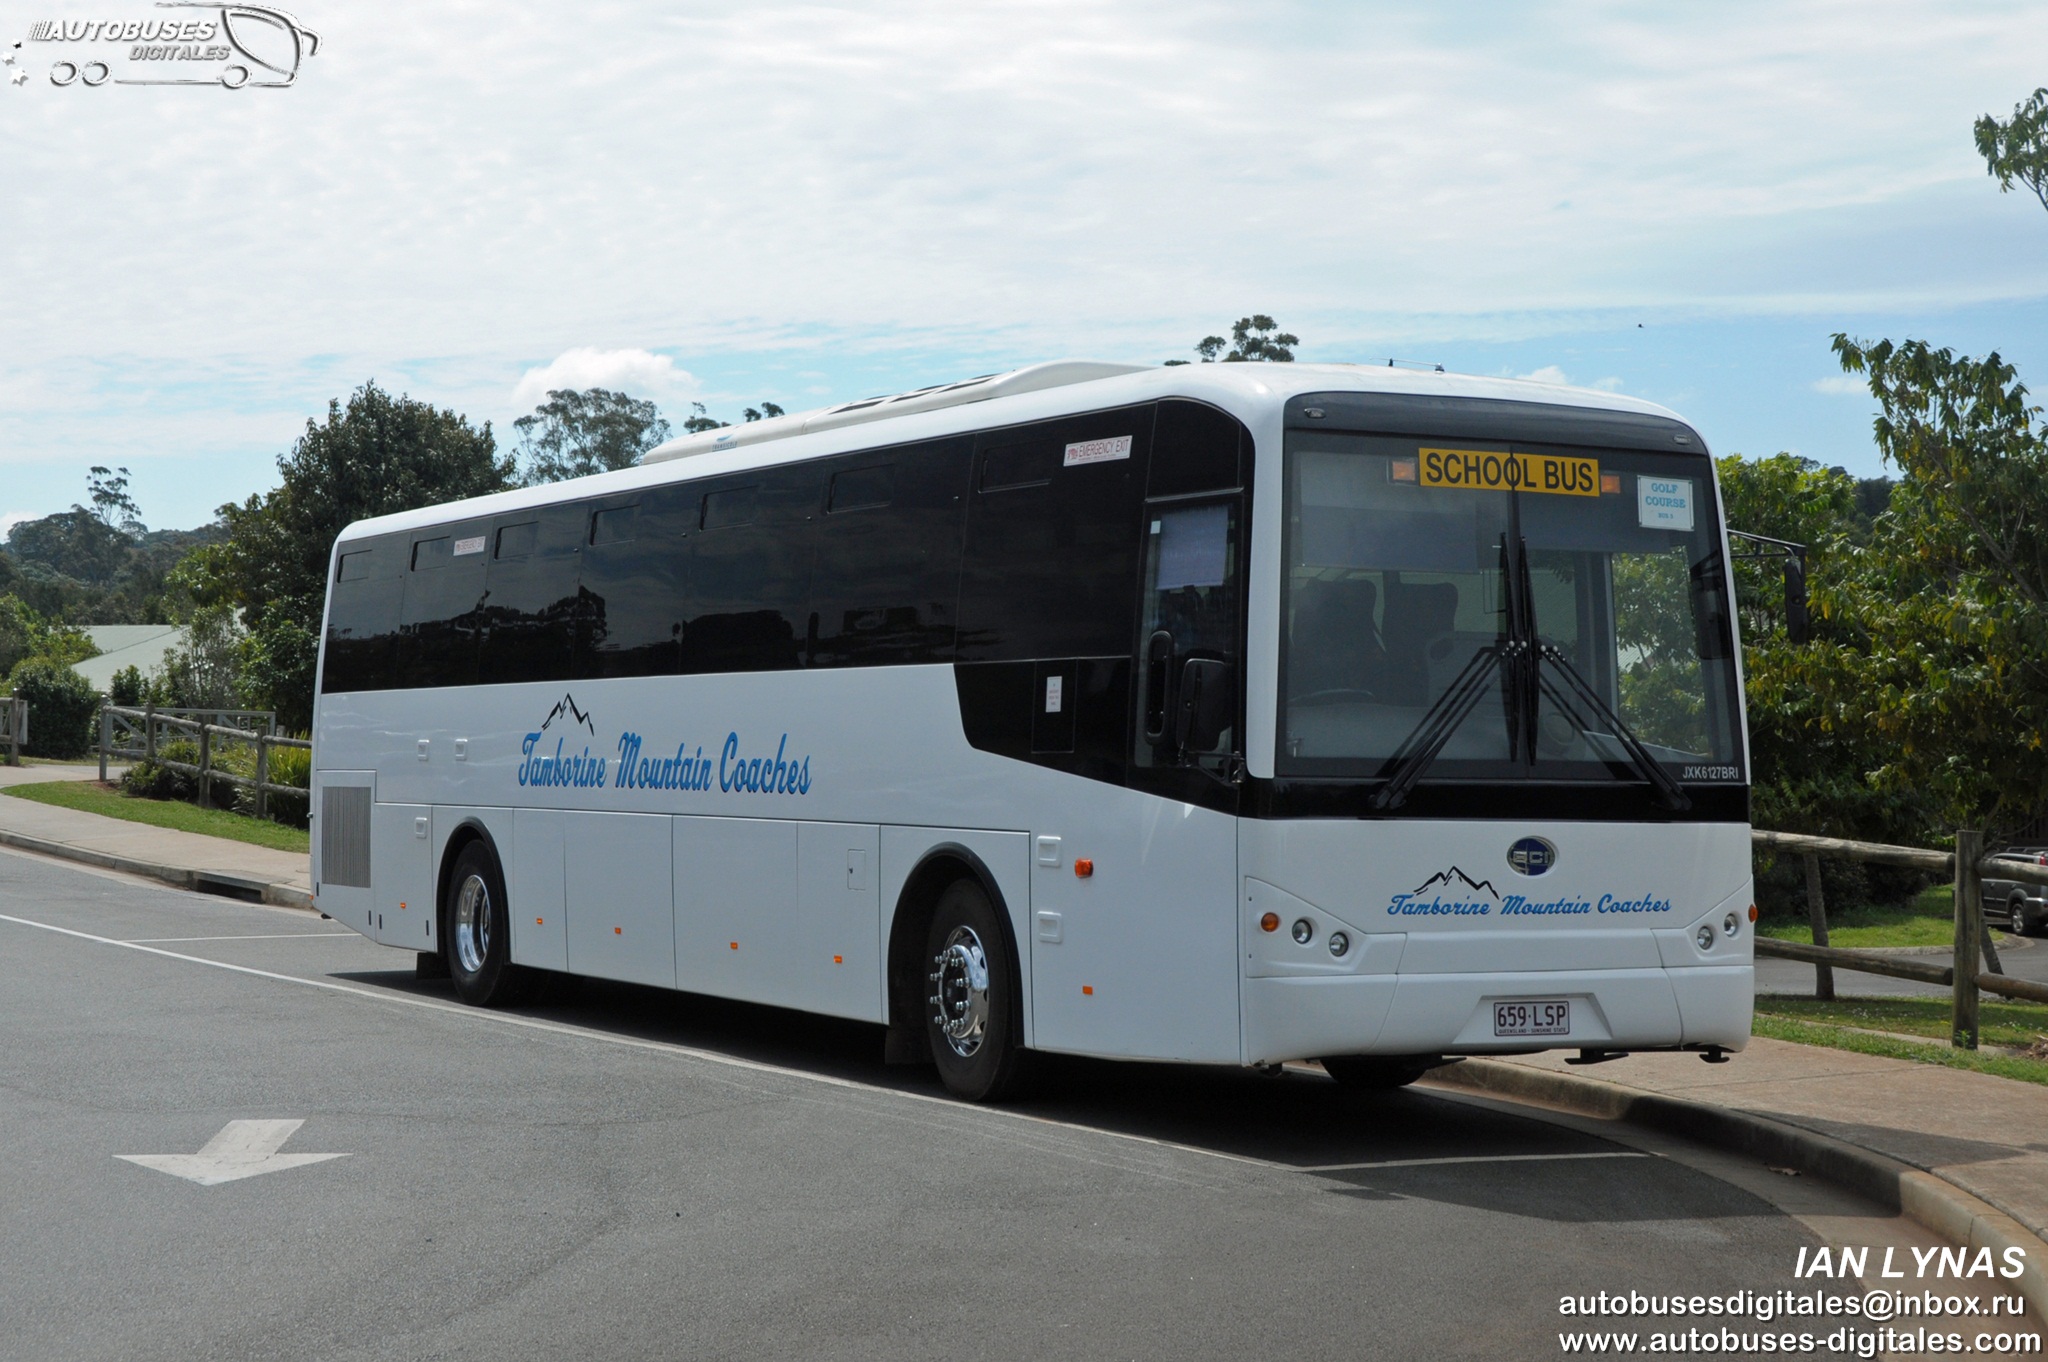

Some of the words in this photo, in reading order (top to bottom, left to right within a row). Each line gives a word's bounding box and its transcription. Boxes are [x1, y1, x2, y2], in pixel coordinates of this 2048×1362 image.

[1079, 441, 1114, 457] EMERGENCY
[1115, 438, 1129, 452] EXIT
[1426, 452, 1537, 488] SCHOOL
[1544, 460, 1594, 492] BUS
[1651, 482, 1679, 494] GOLF
[1645, 495, 1686, 509] COURSE
[518, 731, 607, 788] Tamborine
[615, 731, 713, 791] Mountain
[719, 731, 812, 795] Coaches
[1682, 766, 1739, 779] JXK6127BRI
[1387, 894, 1491, 916] Tamborine
[1500, 895, 1593, 916] Mountain
[1597, 893, 1672, 914] Coaches
